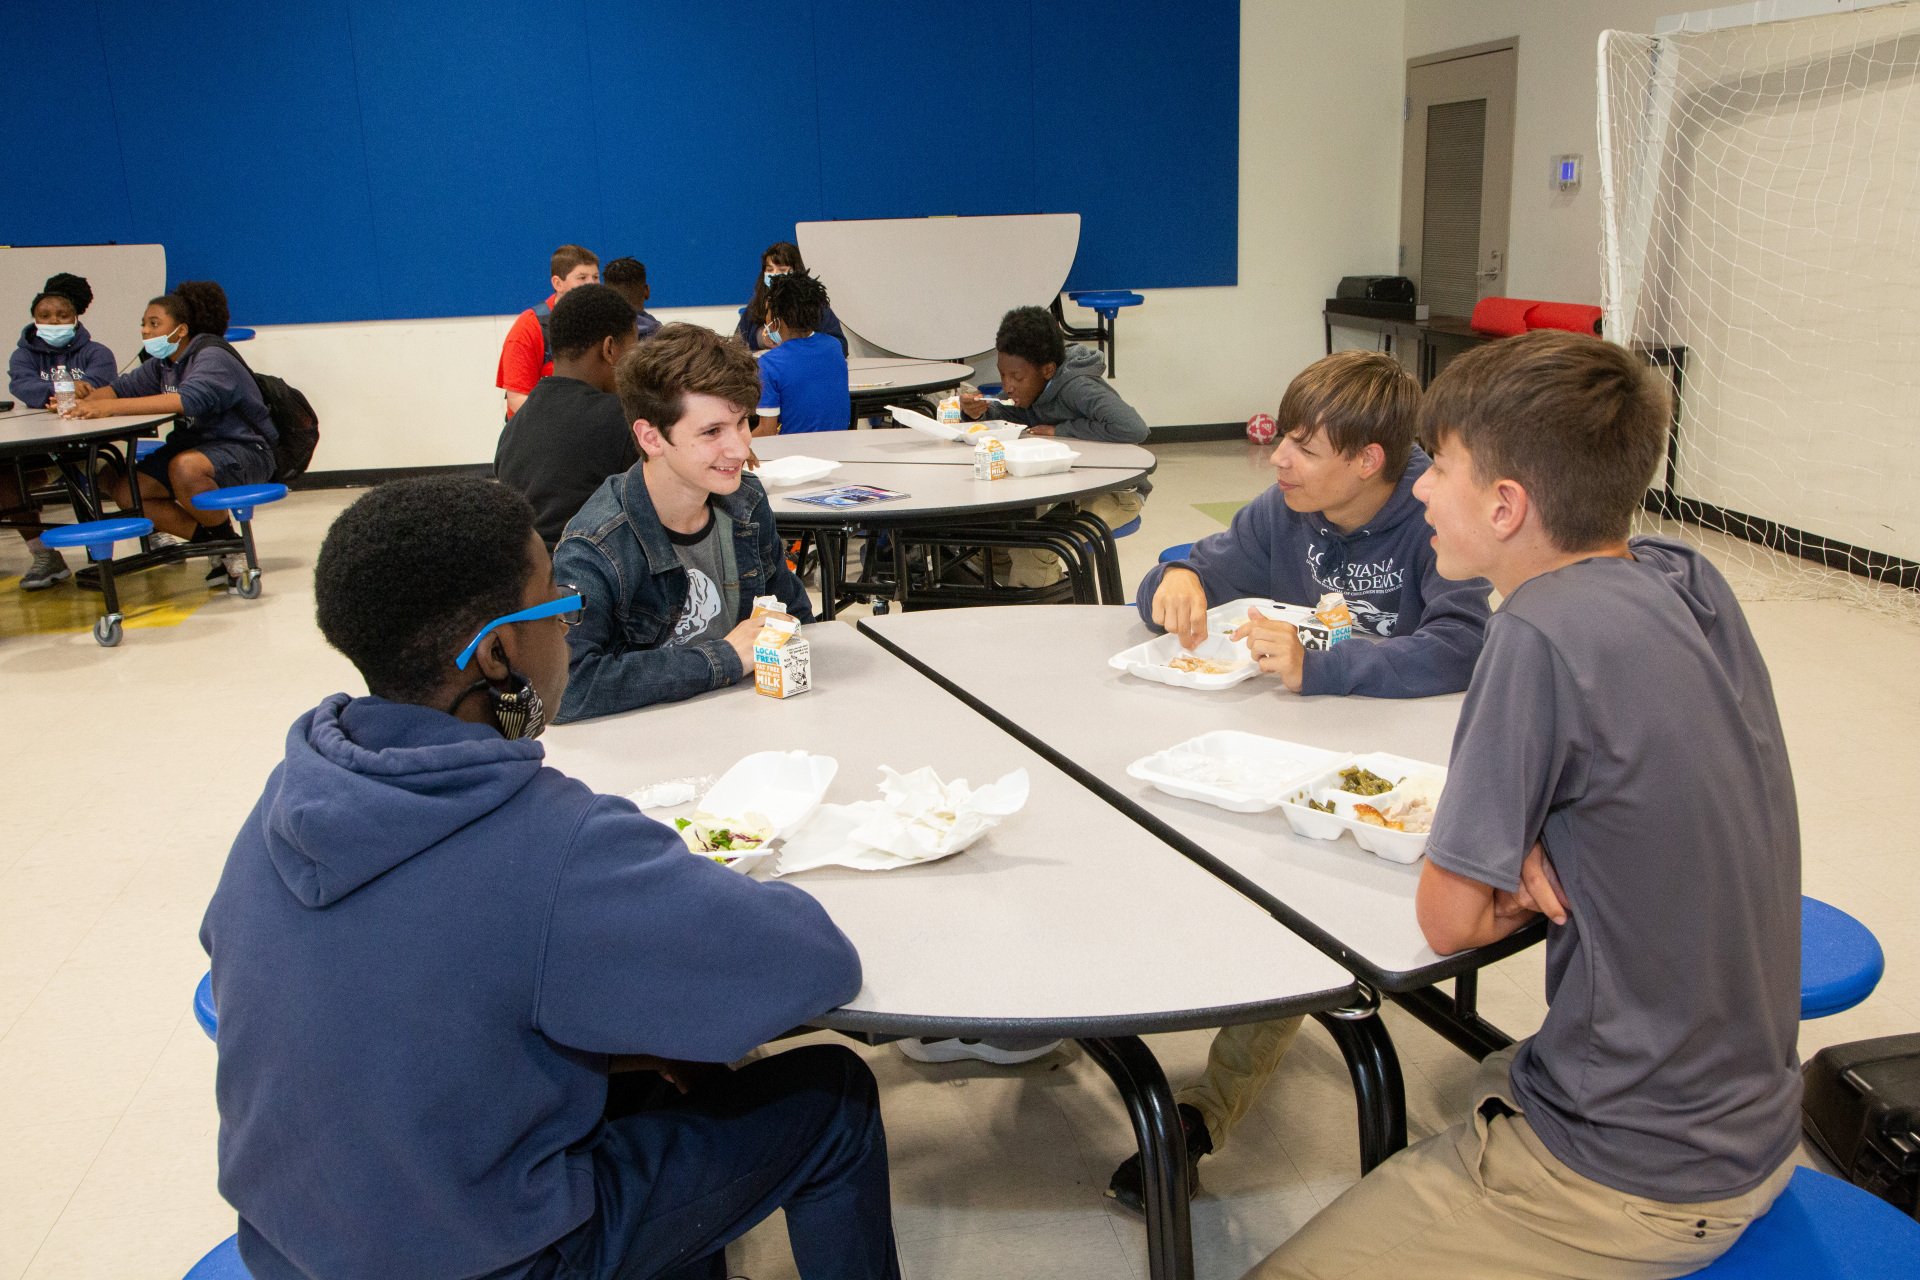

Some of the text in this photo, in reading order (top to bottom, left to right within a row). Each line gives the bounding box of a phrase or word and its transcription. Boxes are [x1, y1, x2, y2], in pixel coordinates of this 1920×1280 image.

[1308, 543, 1394, 578] LOSIANA
[1332, 627, 1351, 637] LOCAL
[755, 646, 779, 657] LOCAL
[756, 654, 780, 666] FRESH
[756, 675, 781, 688] MILK
